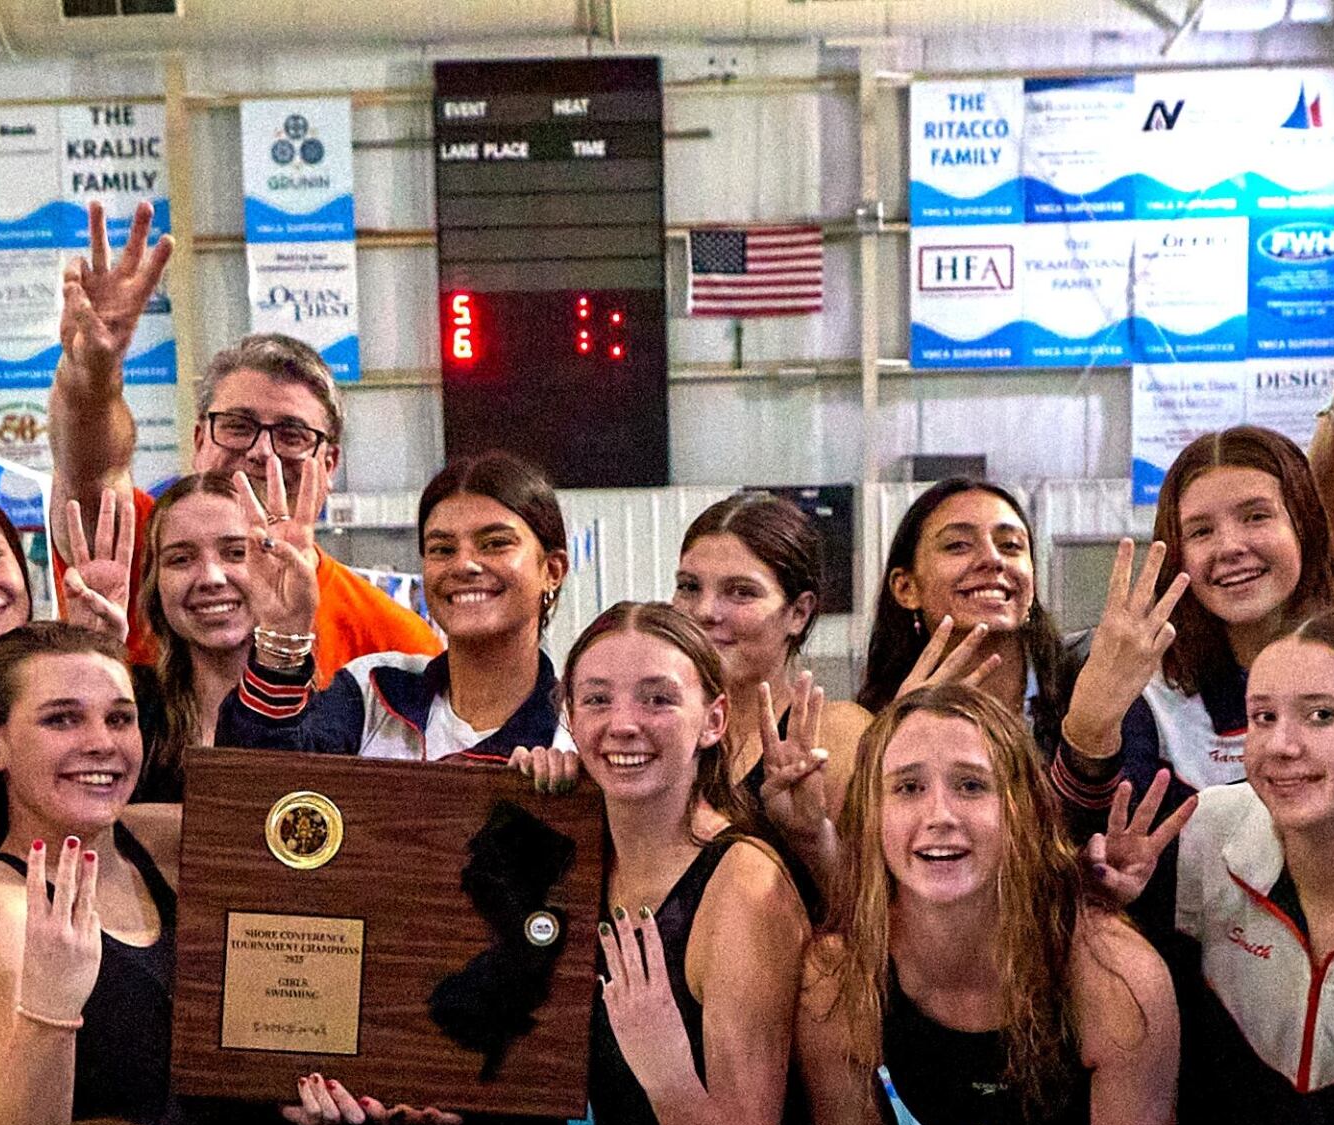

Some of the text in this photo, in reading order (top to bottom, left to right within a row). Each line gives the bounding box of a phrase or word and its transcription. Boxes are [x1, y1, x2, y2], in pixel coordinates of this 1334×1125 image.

[444, 99, 590, 118] EVENT HEAT
[947, 92, 986, 112] THE
[89, 106, 135, 127] THE
[923, 118, 1010, 139] RITACCO
[67, 137, 161, 160] KRALJIC
[441, 139, 606, 160] LANE PLACE TIME
[930, 147, 1002, 167] FAMILY
[71, 171, 157, 194] FAMILY
[935, 255, 1005, 290] HFA
[293, 301, 351, 322] FIRST
[452, 294, 473, 326] 5
[453, 327, 474, 359] 6
[952, 347, 1012, 359] SUPPORTER
[244, 929, 347, 944] SHORE CONFERENCE
[230, 939, 360, 956] TOURNAMENT CHAMPIONS
[278, 976, 309, 988] GIRLS
[265, 986, 319, 1000] SWIMMING
